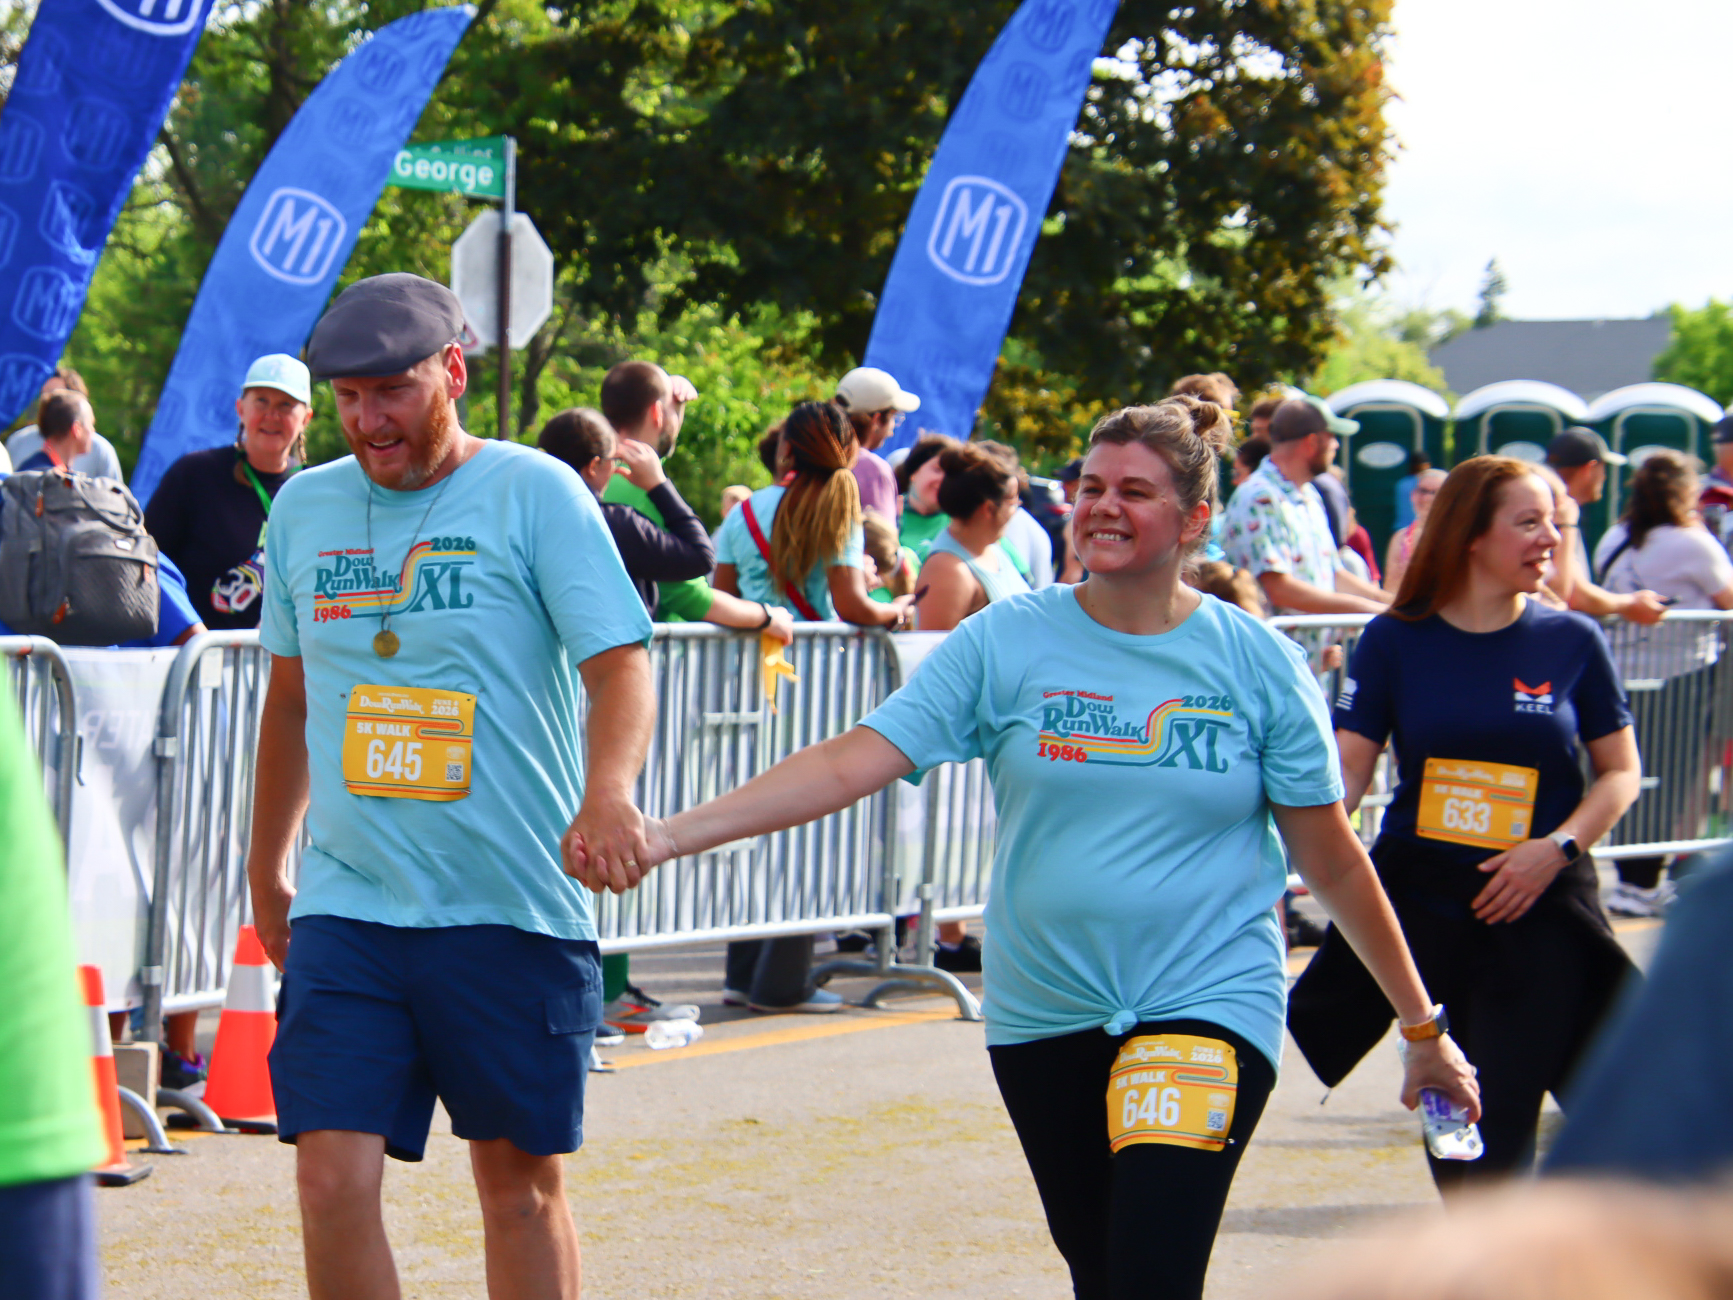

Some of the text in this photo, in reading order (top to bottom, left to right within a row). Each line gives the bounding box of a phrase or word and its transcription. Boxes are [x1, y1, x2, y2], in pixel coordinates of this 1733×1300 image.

[394, 151, 494, 191] George
[263, 196, 333, 276] M1
[941, 187, 1014, 274] M1
[431, 536, 476, 551] 2026
[334, 555, 374, 577] Dow
[314, 566, 402, 600] RunWalk
[409, 563, 474, 612] XL
[313, 605, 352, 623] 1986
[1043, 690, 1113, 701] Greater Midland
[1066, 695, 1114, 718] Dow
[1181, 695, 1233, 711] 2026
[431, 705, 459, 716] 2026
[1515, 703, 1553, 715] KEEL
[357, 722, 411, 737] 5K WALK
[1042, 707, 1149, 744] RunWalk
[1037, 743, 1087, 763] 1986
[1158, 718, 1229, 774] XL
[367, 739, 423, 781] 645
[1443, 798, 1491, 833] 633
[1190, 1052, 1223, 1063] 2026
[1131, 1071, 1166, 1085] WALK
[1123, 1087, 1181, 1128] 646
